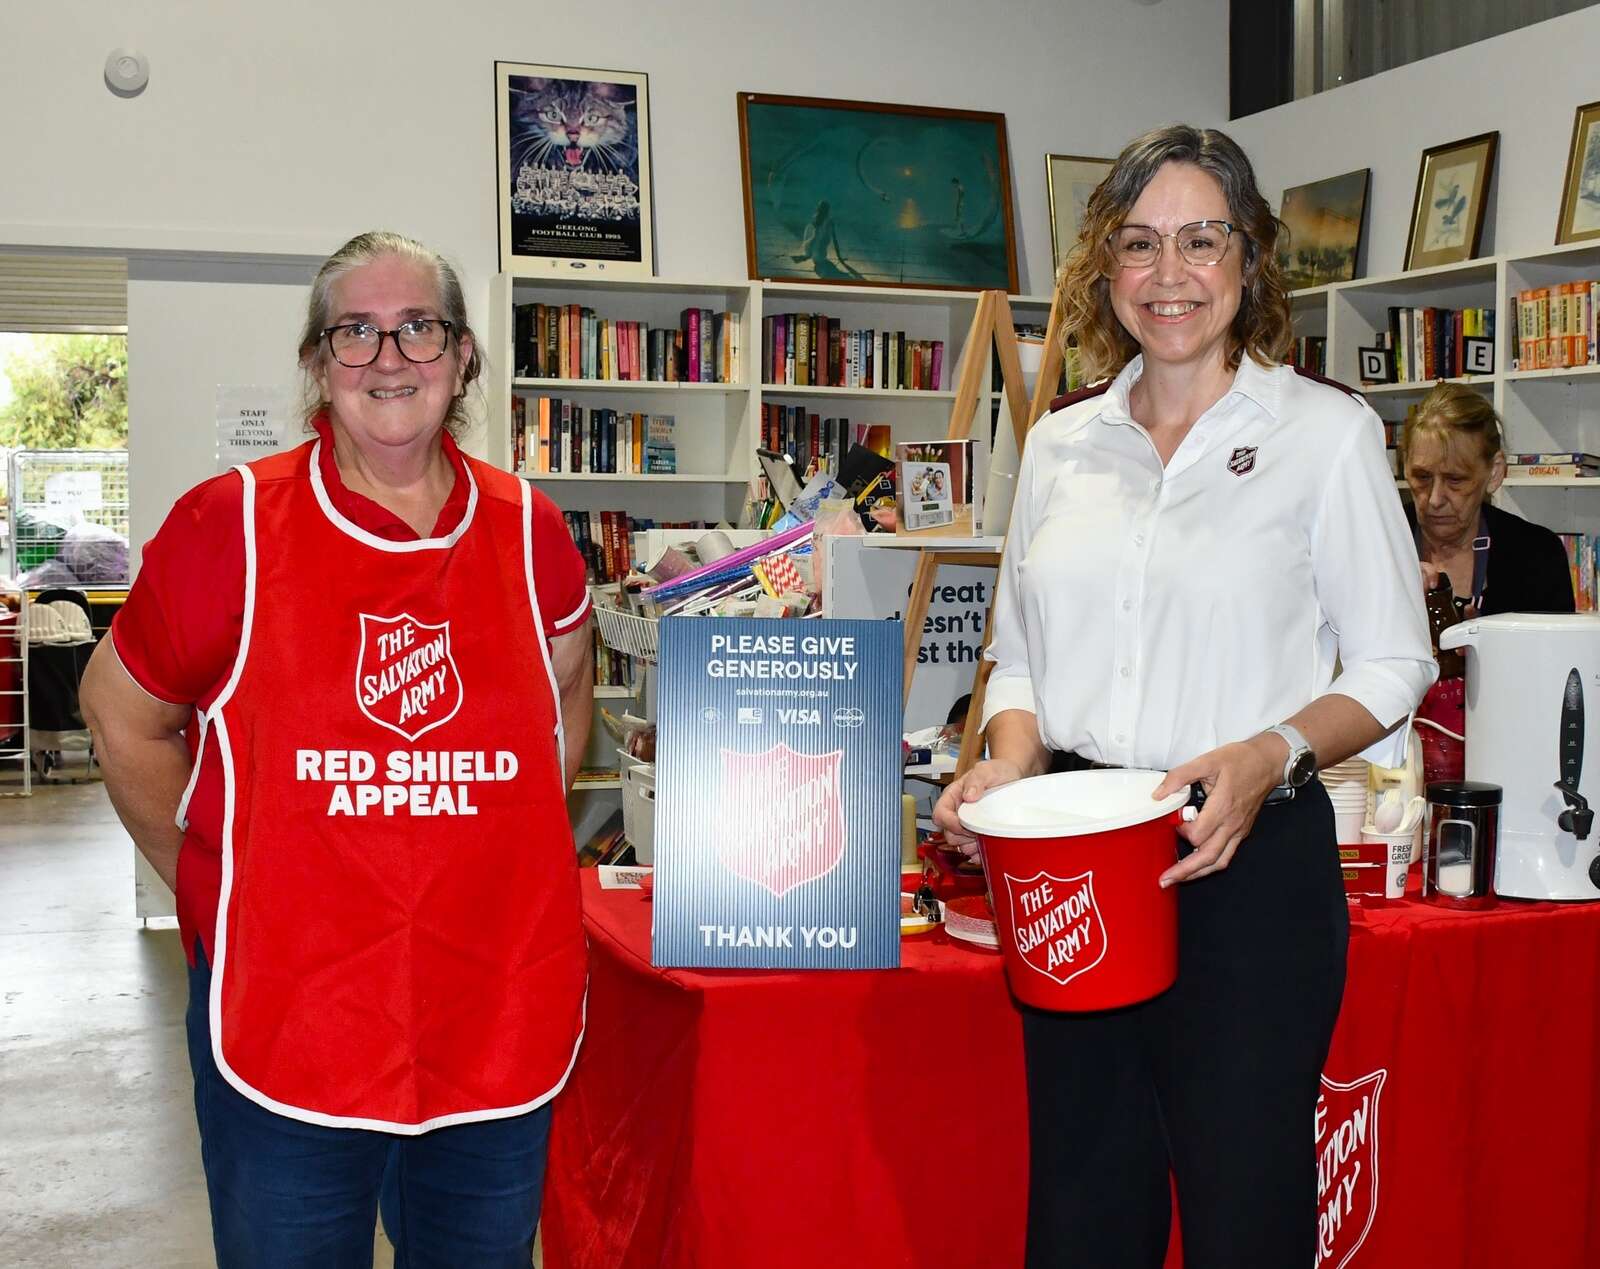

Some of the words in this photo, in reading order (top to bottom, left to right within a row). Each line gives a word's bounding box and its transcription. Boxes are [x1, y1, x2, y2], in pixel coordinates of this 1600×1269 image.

[532, 229, 578, 238] FOOTBALL
[799, 336, 808, 363] BROWN
[1475, 346, 1486, 366] E
[1368, 356, 1381, 374] D
[908, 582, 984, 602] reat
[377, 622, 415, 662] THE
[712, 635, 795, 654] PLEASE
[801, 637, 855, 656] GIVE
[363, 634, 446, 706] SALVATION
[707, 660, 858, 680] GENEROUSLY
[398, 665, 446, 725] ARMY
[736, 688, 829, 698] salvationarmy.org.au
[776, 708, 820, 724] VISA
[296, 750, 376, 781] RED
[386, 750, 519, 782] SHIELD
[327, 784, 478, 816] APPEAL
[1020, 881, 1054, 916] THE
[1018, 883, 1090, 953] SALVATION
[700, 926, 793, 948] THANK
[801, 927, 857, 948] YOU
[1048, 916, 1090, 972] ARMY
[1316, 1096, 1368, 1206] ATION
[1314, 1160, 1360, 1268] RMY
